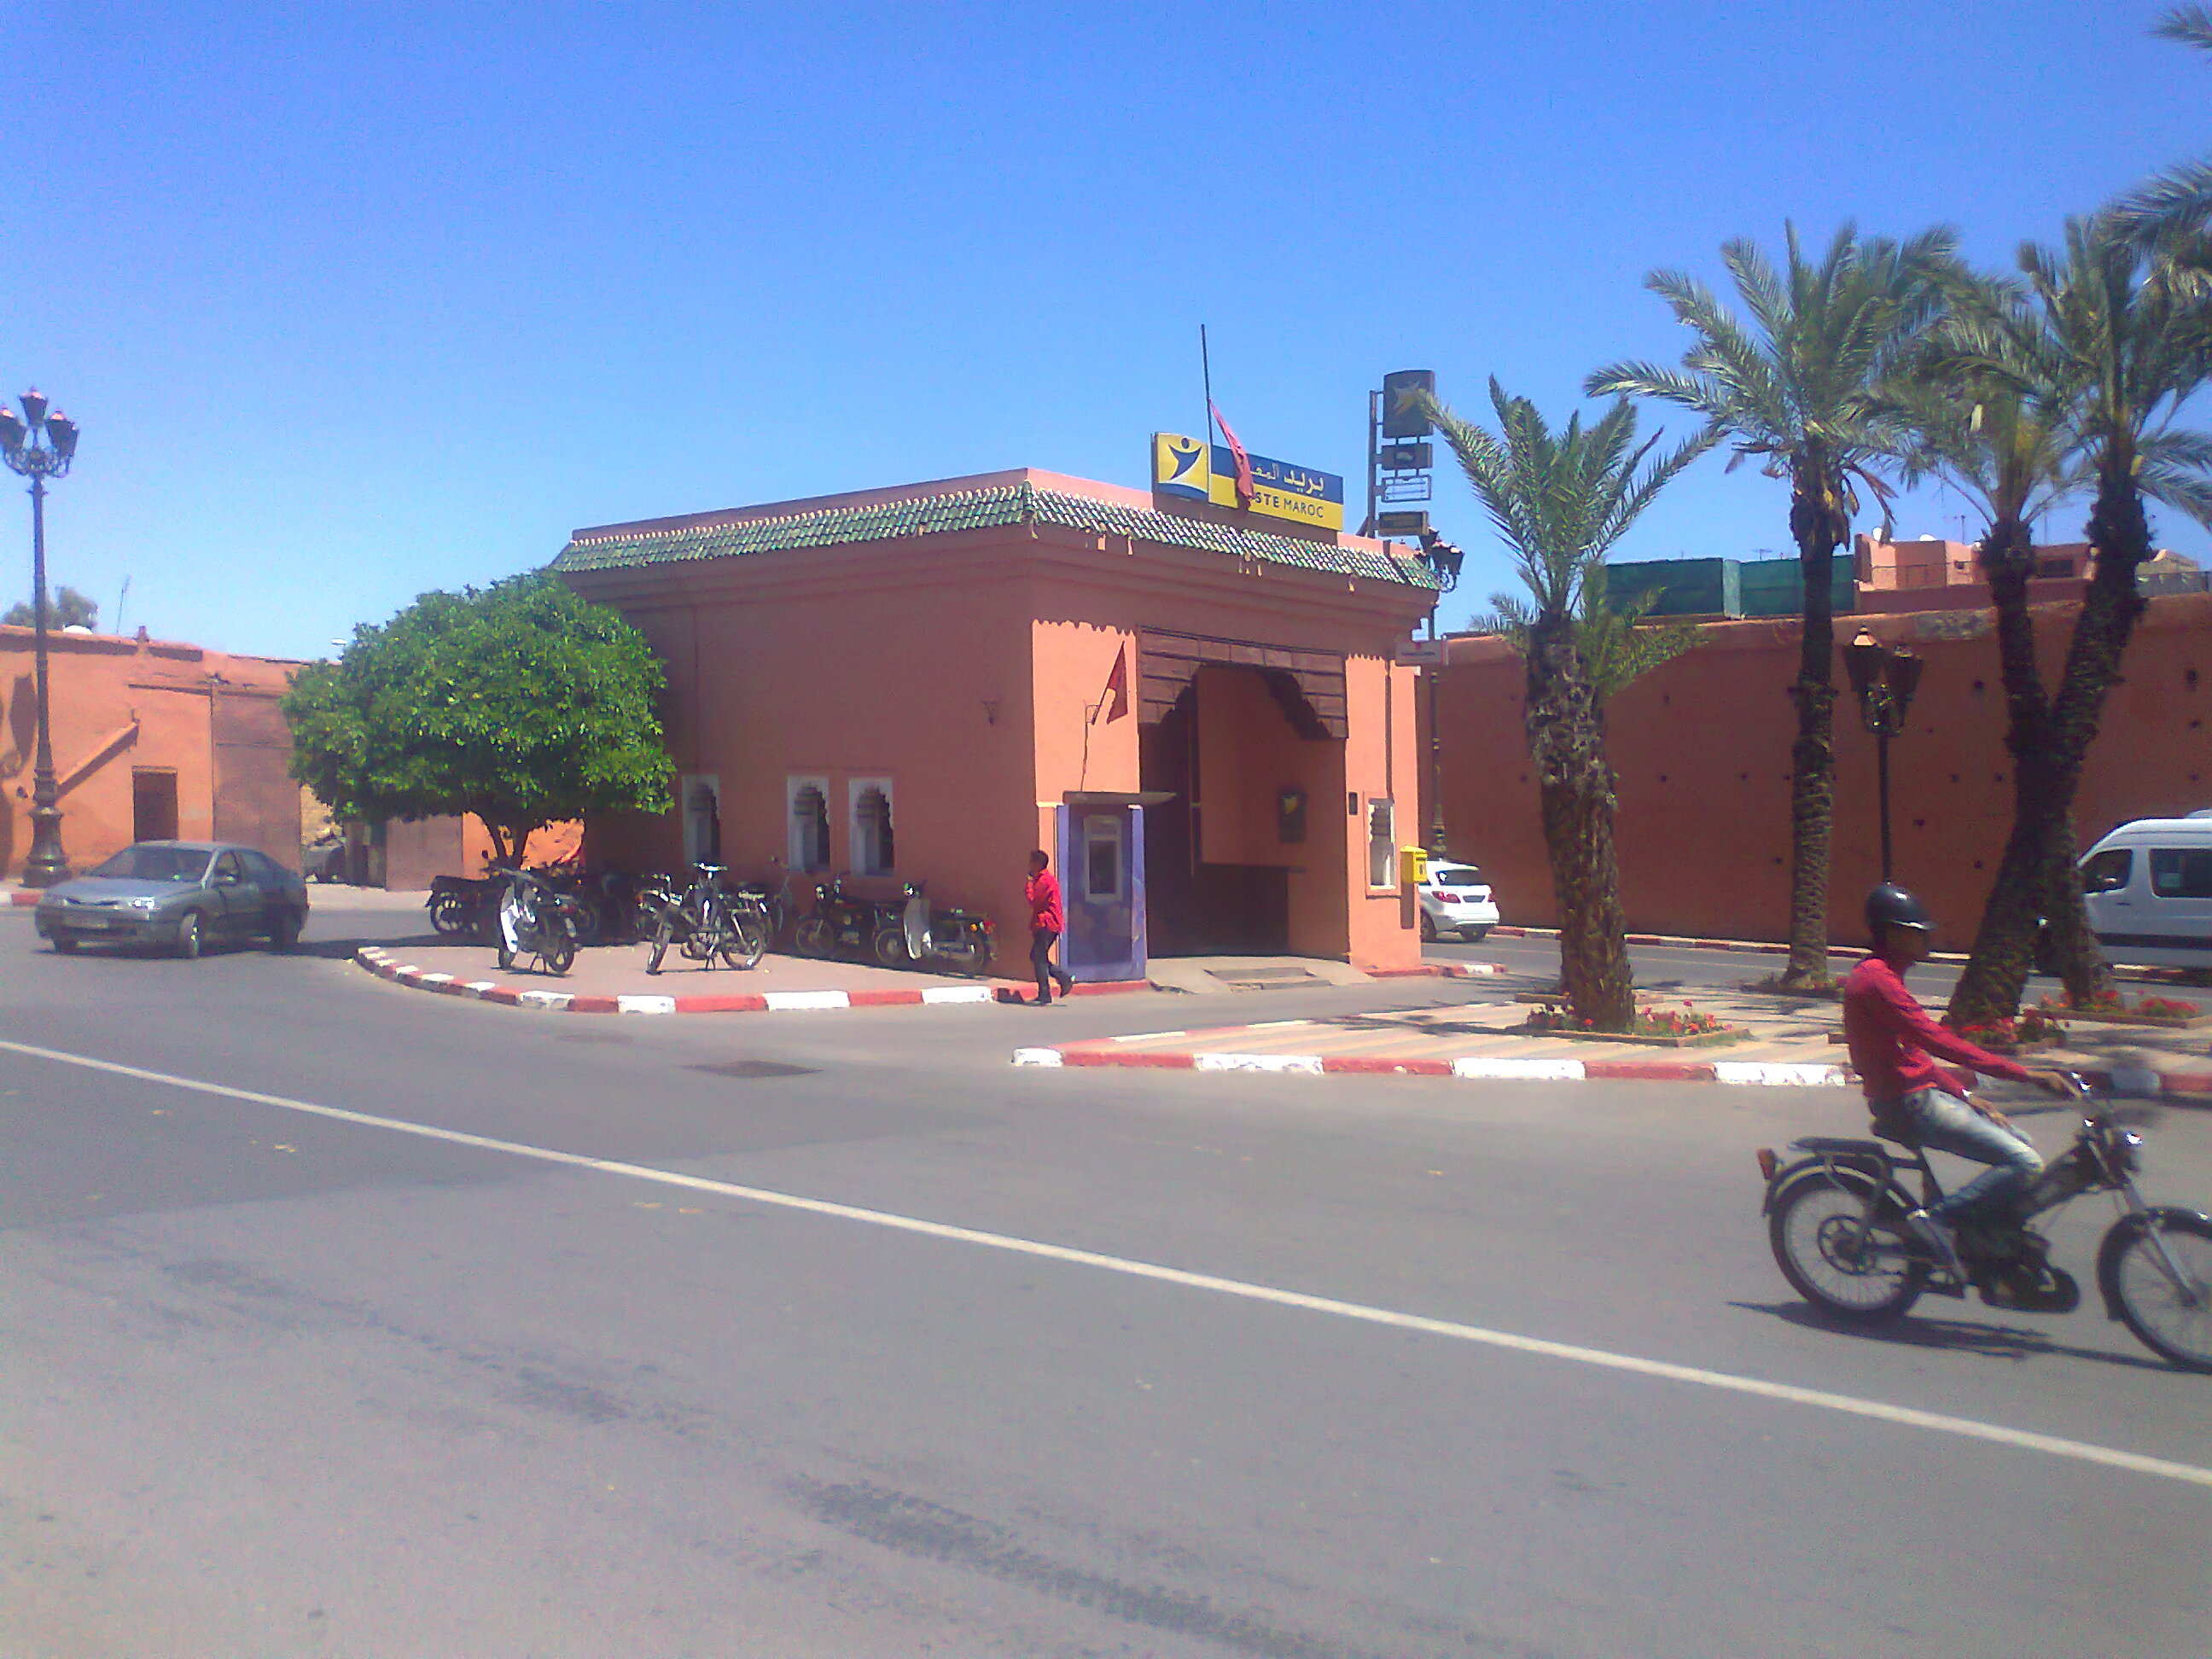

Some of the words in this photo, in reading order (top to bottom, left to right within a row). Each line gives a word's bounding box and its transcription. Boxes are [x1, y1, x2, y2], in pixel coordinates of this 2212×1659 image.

[1249, 462, 1280, 480] المغ
[1284, 469, 1324, 498] بريد
[1255, 492, 1280, 509] STE
[1284, 498, 1324, 518] MAROC
